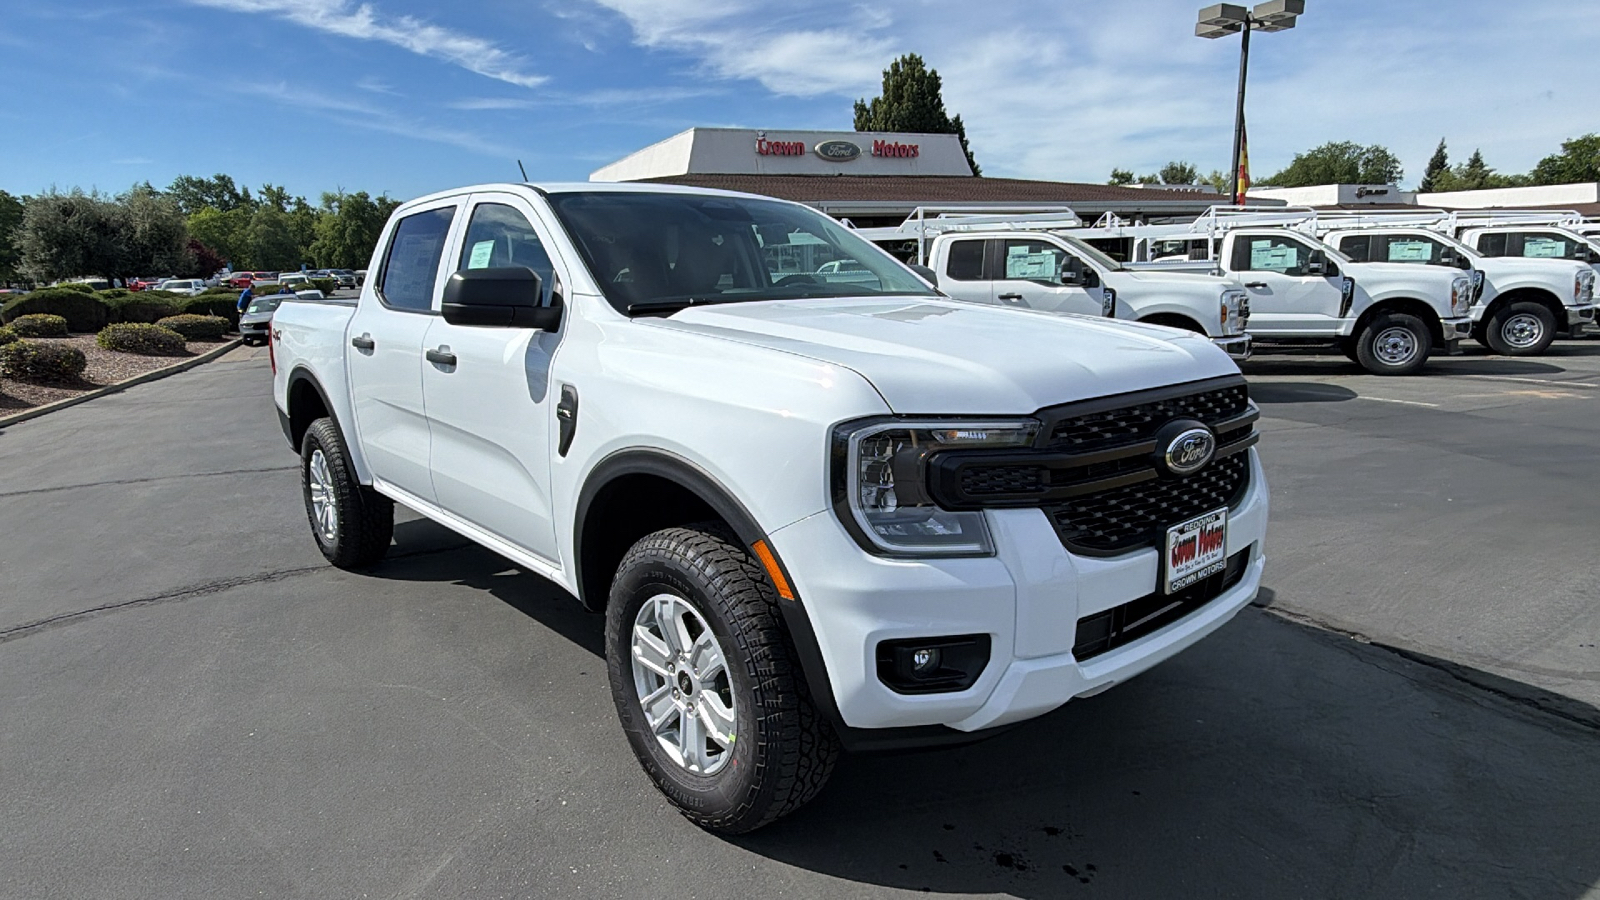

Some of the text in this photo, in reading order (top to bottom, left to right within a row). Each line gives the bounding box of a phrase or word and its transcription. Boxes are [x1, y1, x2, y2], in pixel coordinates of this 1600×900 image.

[756, 137, 920, 158] Crown Motors
[827, 144, 853, 158] Ford
[1180, 437, 1208, 464] Ford
[1184, 513, 1216, 532] REDDING
[1171, 573, 1197, 591] CROWN
[1197, 560, 1225, 580] MOTORS
[658, 776, 705, 809] TERRITORY
